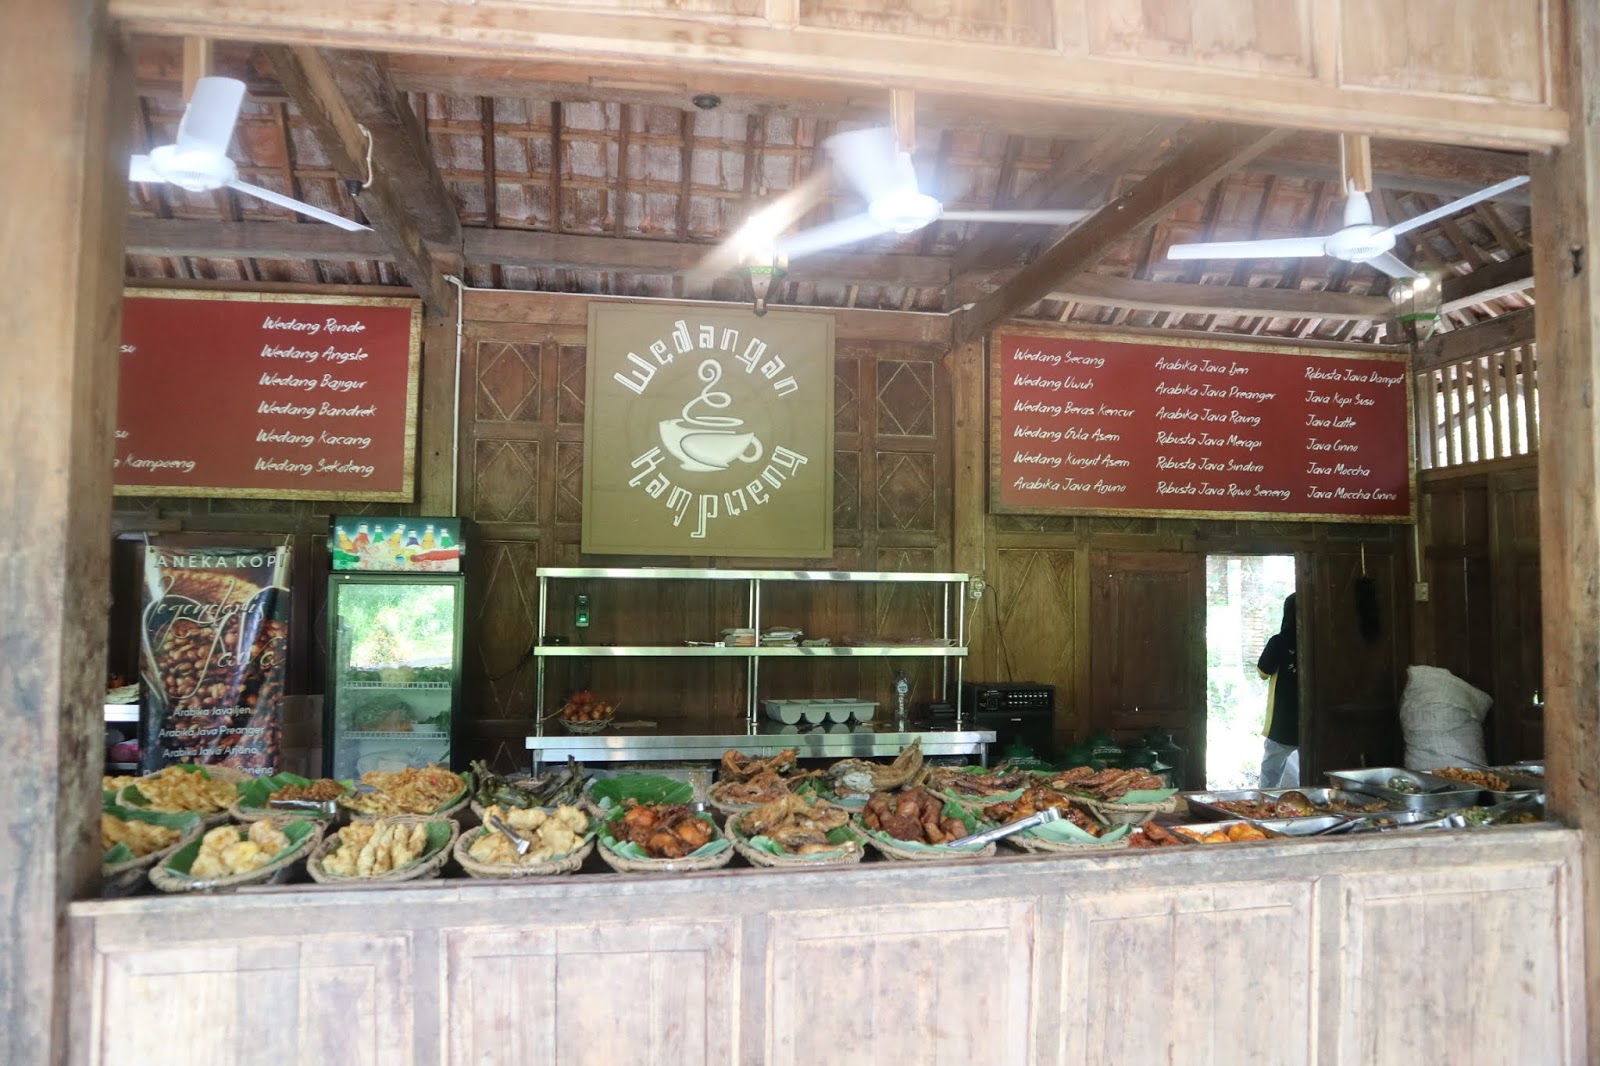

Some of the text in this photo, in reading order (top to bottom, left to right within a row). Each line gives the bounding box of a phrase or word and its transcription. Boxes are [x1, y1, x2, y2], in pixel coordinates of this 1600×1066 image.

[262, 316, 366, 335] Wedang Ronde
[260, 344, 368, 364] Wedang Angsle
[613, 320, 799, 397] Wedangan
[1014, 348, 1105, 369] Wedang Secang
[1155, 357, 1249, 376] Arabika Java Ijen
[259, 372, 368, 393] Wedang Bajigur
[1014, 373, 1094, 392] Wedang Uwuh
[1304, 366, 1404, 388] Robusta Java Dampit
[1155, 382, 1277, 403] Arabika Java Preanger
[1305, 390, 1375, 408] Java Kopi Susu
[257, 400, 378, 419] Wedang Bandrek
[1014, 399, 1136, 417] Wedang Beras Kencur
[1155, 406, 1261, 427] Arabika Java Raung
[1305, 414, 1357, 428] Java Latte
[256, 428, 372, 449] Wedang Kacang
[1014, 425, 1120, 443] Wedang Gula Asem
[1156, 431, 1262, 451] Robusta Java Merapi
[1306, 438, 1331, 451] Java
[124, 453, 197, 473] Kampoeng
[254, 457, 375, 478] Wedang Sekoteng
[1014, 451, 1130, 469] Wedang Kunyit Asem
[1156, 456, 1264, 472] Robusta Java Sindoro
[1306, 462, 1370, 476] Java Moccha
[628, 446, 808, 538] Kampoeng
[1014, 476, 1060, 491] Arabika
[1062, 477, 1090, 492] Java
[1156, 481, 1291, 501] Robusta Java Rowo Seneng
[1307, 485, 1333, 499] Java
[1334, 486, 1371, 500] Moccha
[155, 555, 228, 568] ANEKA
[173, 707, 209, 717] Arabika
[158, 725, 265, 738] Arabika Java Preanger
[162, 748, 197, 758] Arabika
[198, 747, 221, 756] Java
